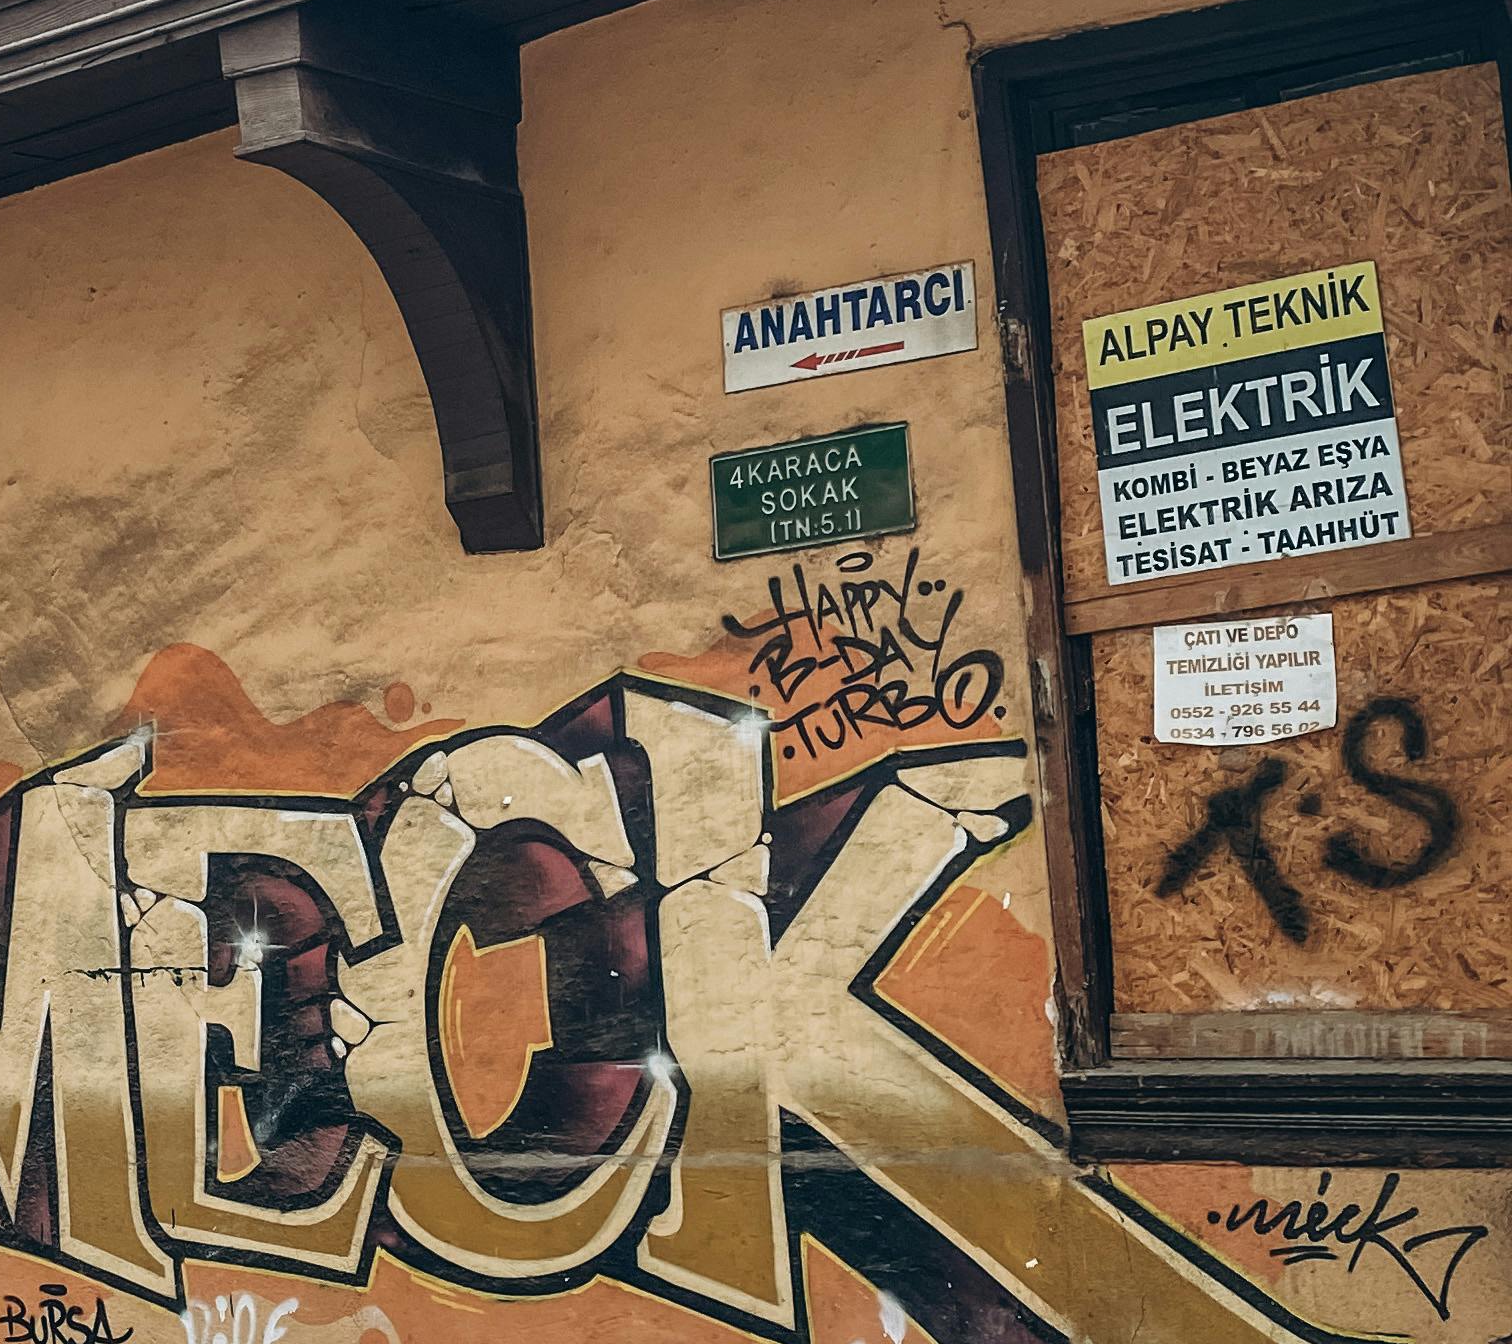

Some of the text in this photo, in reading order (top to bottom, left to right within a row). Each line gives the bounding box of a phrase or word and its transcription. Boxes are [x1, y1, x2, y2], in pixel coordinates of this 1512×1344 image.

[734, 269, 964, 353] ANAHTARCI
[1099, 272, 1370, 366] ALPAY TEKNİK
[1107, 353, 1380, 455] ELEKTRİK
[1114, 463, 1198, 502] KOMBİ
[1222, 448, 1310, 483] BEYAZ
[1318, 435, 1390, 469] EŞYA
[761, 477, 859, 514] SOKAK
[1118, 471, 1393, 539] ELEKTRİK ARIZA
[1117, 538, 1232, 577] TESİSAT
[1258, 512, 1400, 554] TAAHHÜT
[1167, 650, 1321, 675] TEMİZLİĞİ YAPILIR
[1185, 624, 1299, 650] ÇATI VE DEPO
[1170, 706, 1214, 719] 0552
[1230, 704, 1263, 717] 926
[1270, 701, 1292, 715] 55
[1298, 699, 1321, 712] 44
[1204, 679, 1284, 697] İLETİŞİM
[1170, 727, 1214, 739] 0534
[1231, 725, 1265, 738] 796
[1271, 723, 1293, 736] 56
